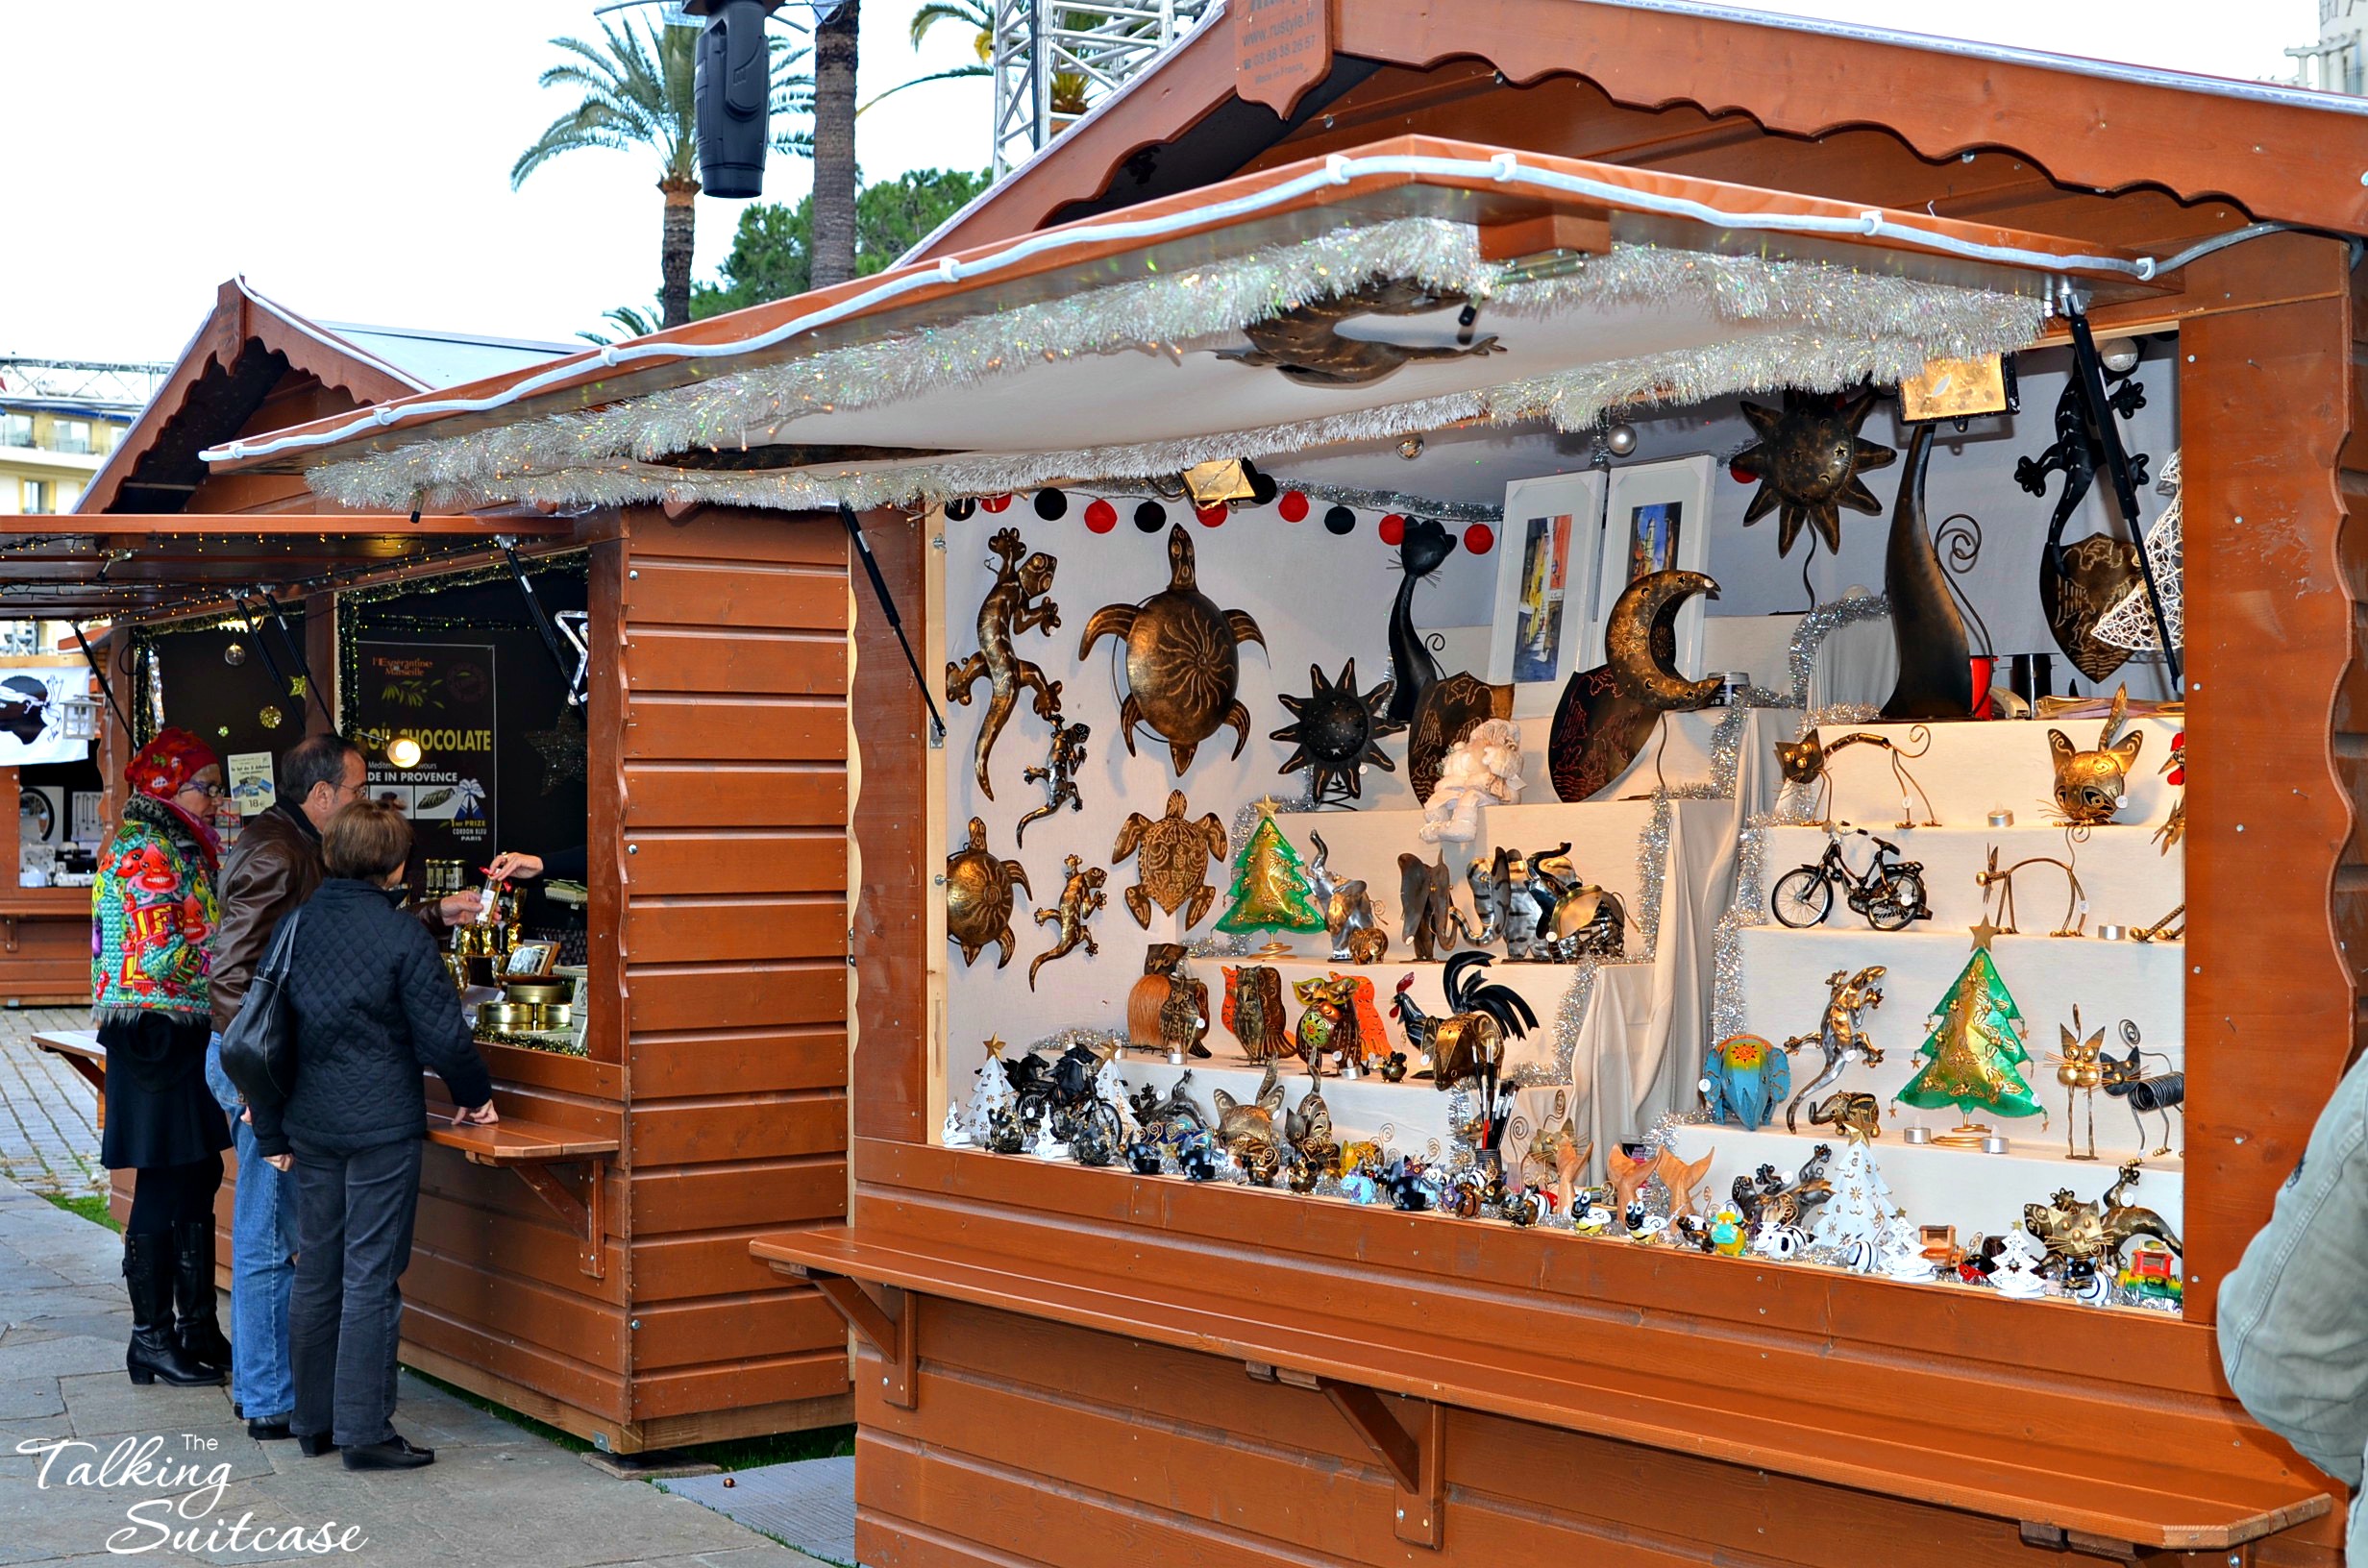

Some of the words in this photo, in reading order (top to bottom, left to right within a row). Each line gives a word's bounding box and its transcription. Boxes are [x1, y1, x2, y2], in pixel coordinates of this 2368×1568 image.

[367, 772, 382, 782] DE
[384, 772, 398, 782] IN
[400, 772, 457, 782] PROVENCE
